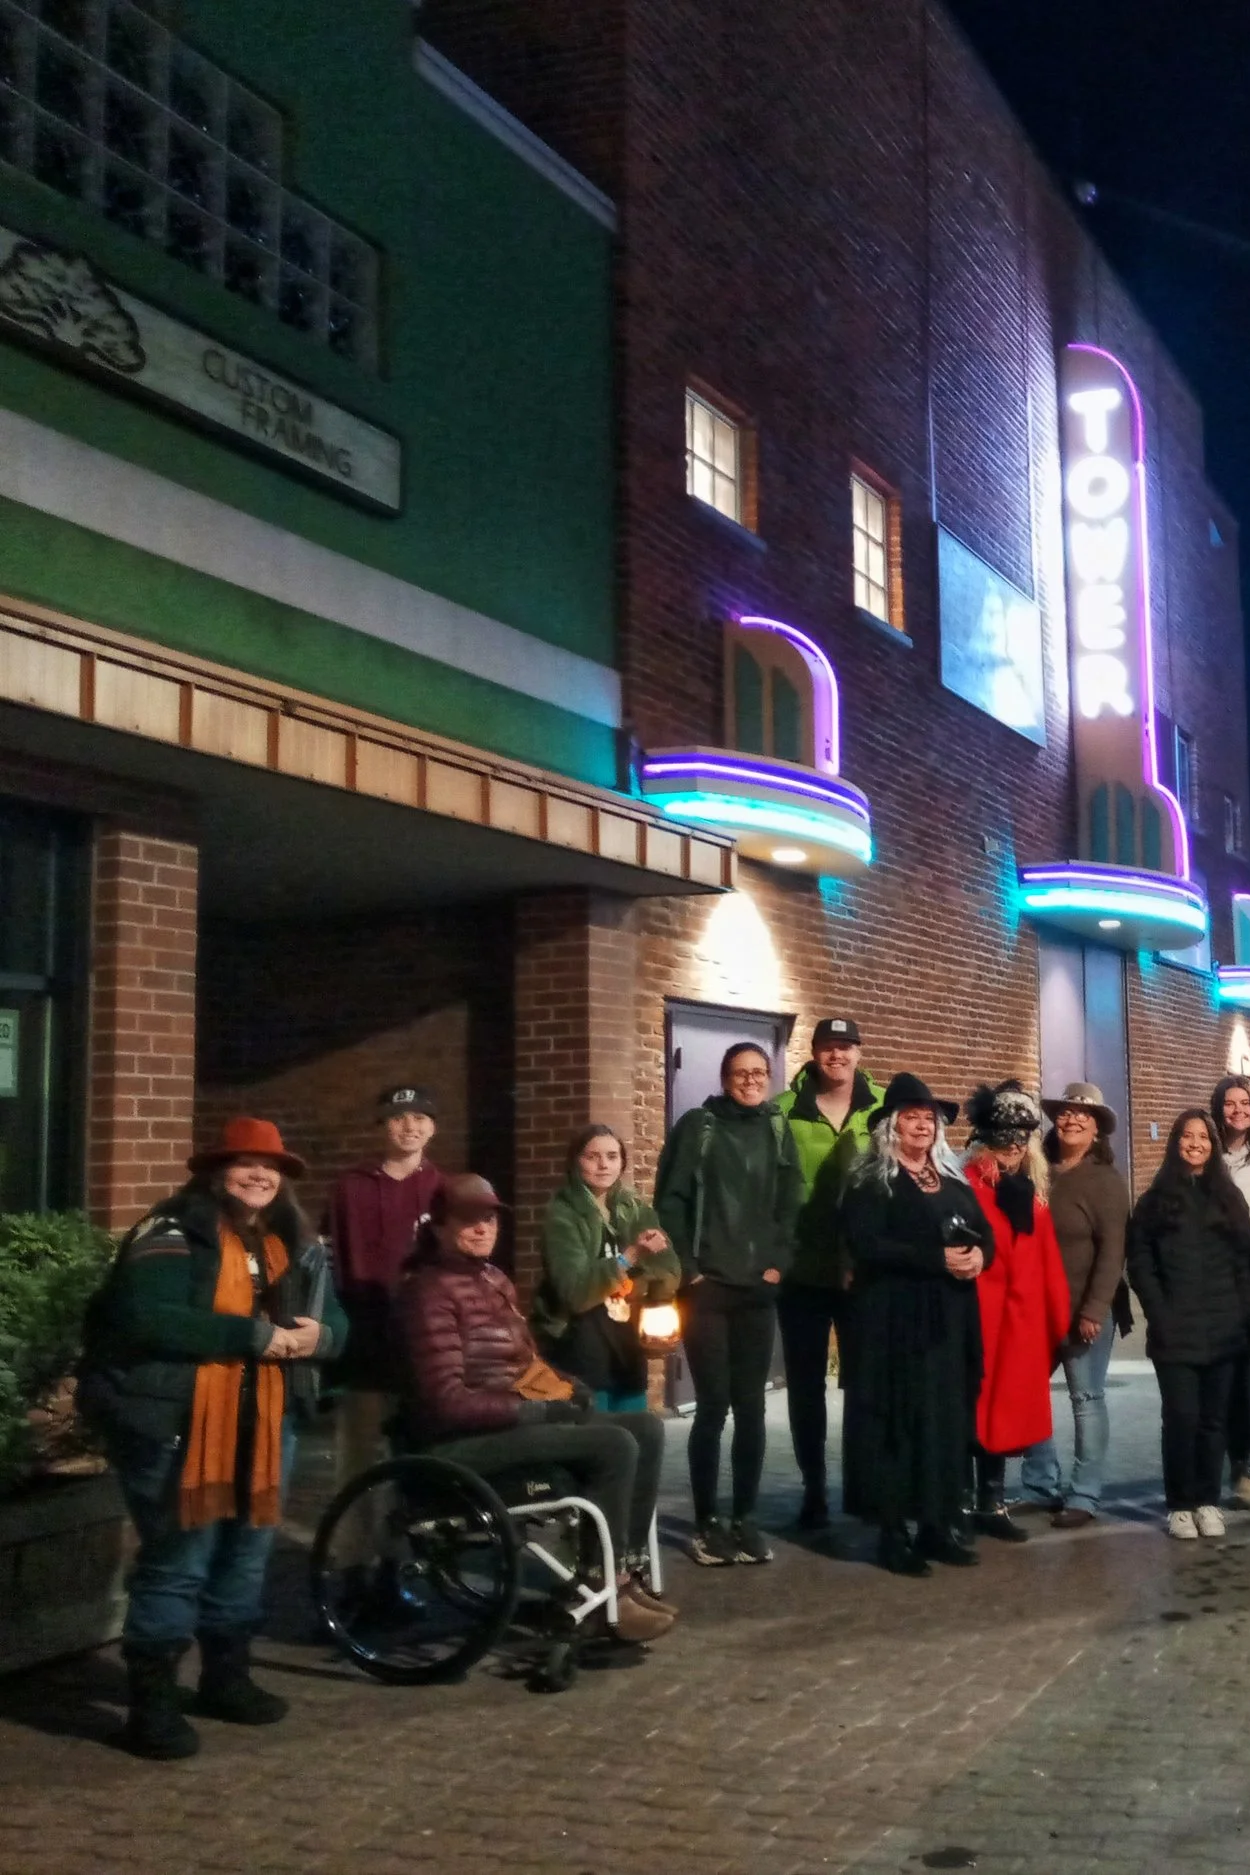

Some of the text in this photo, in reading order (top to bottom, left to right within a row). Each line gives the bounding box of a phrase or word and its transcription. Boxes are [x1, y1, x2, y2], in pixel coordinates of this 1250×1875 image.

[203, 348, 312, 426] CUSTOM
[241, 398, 352, 478] FRAMING
[1067, 387, 1135, 719] TOWER
